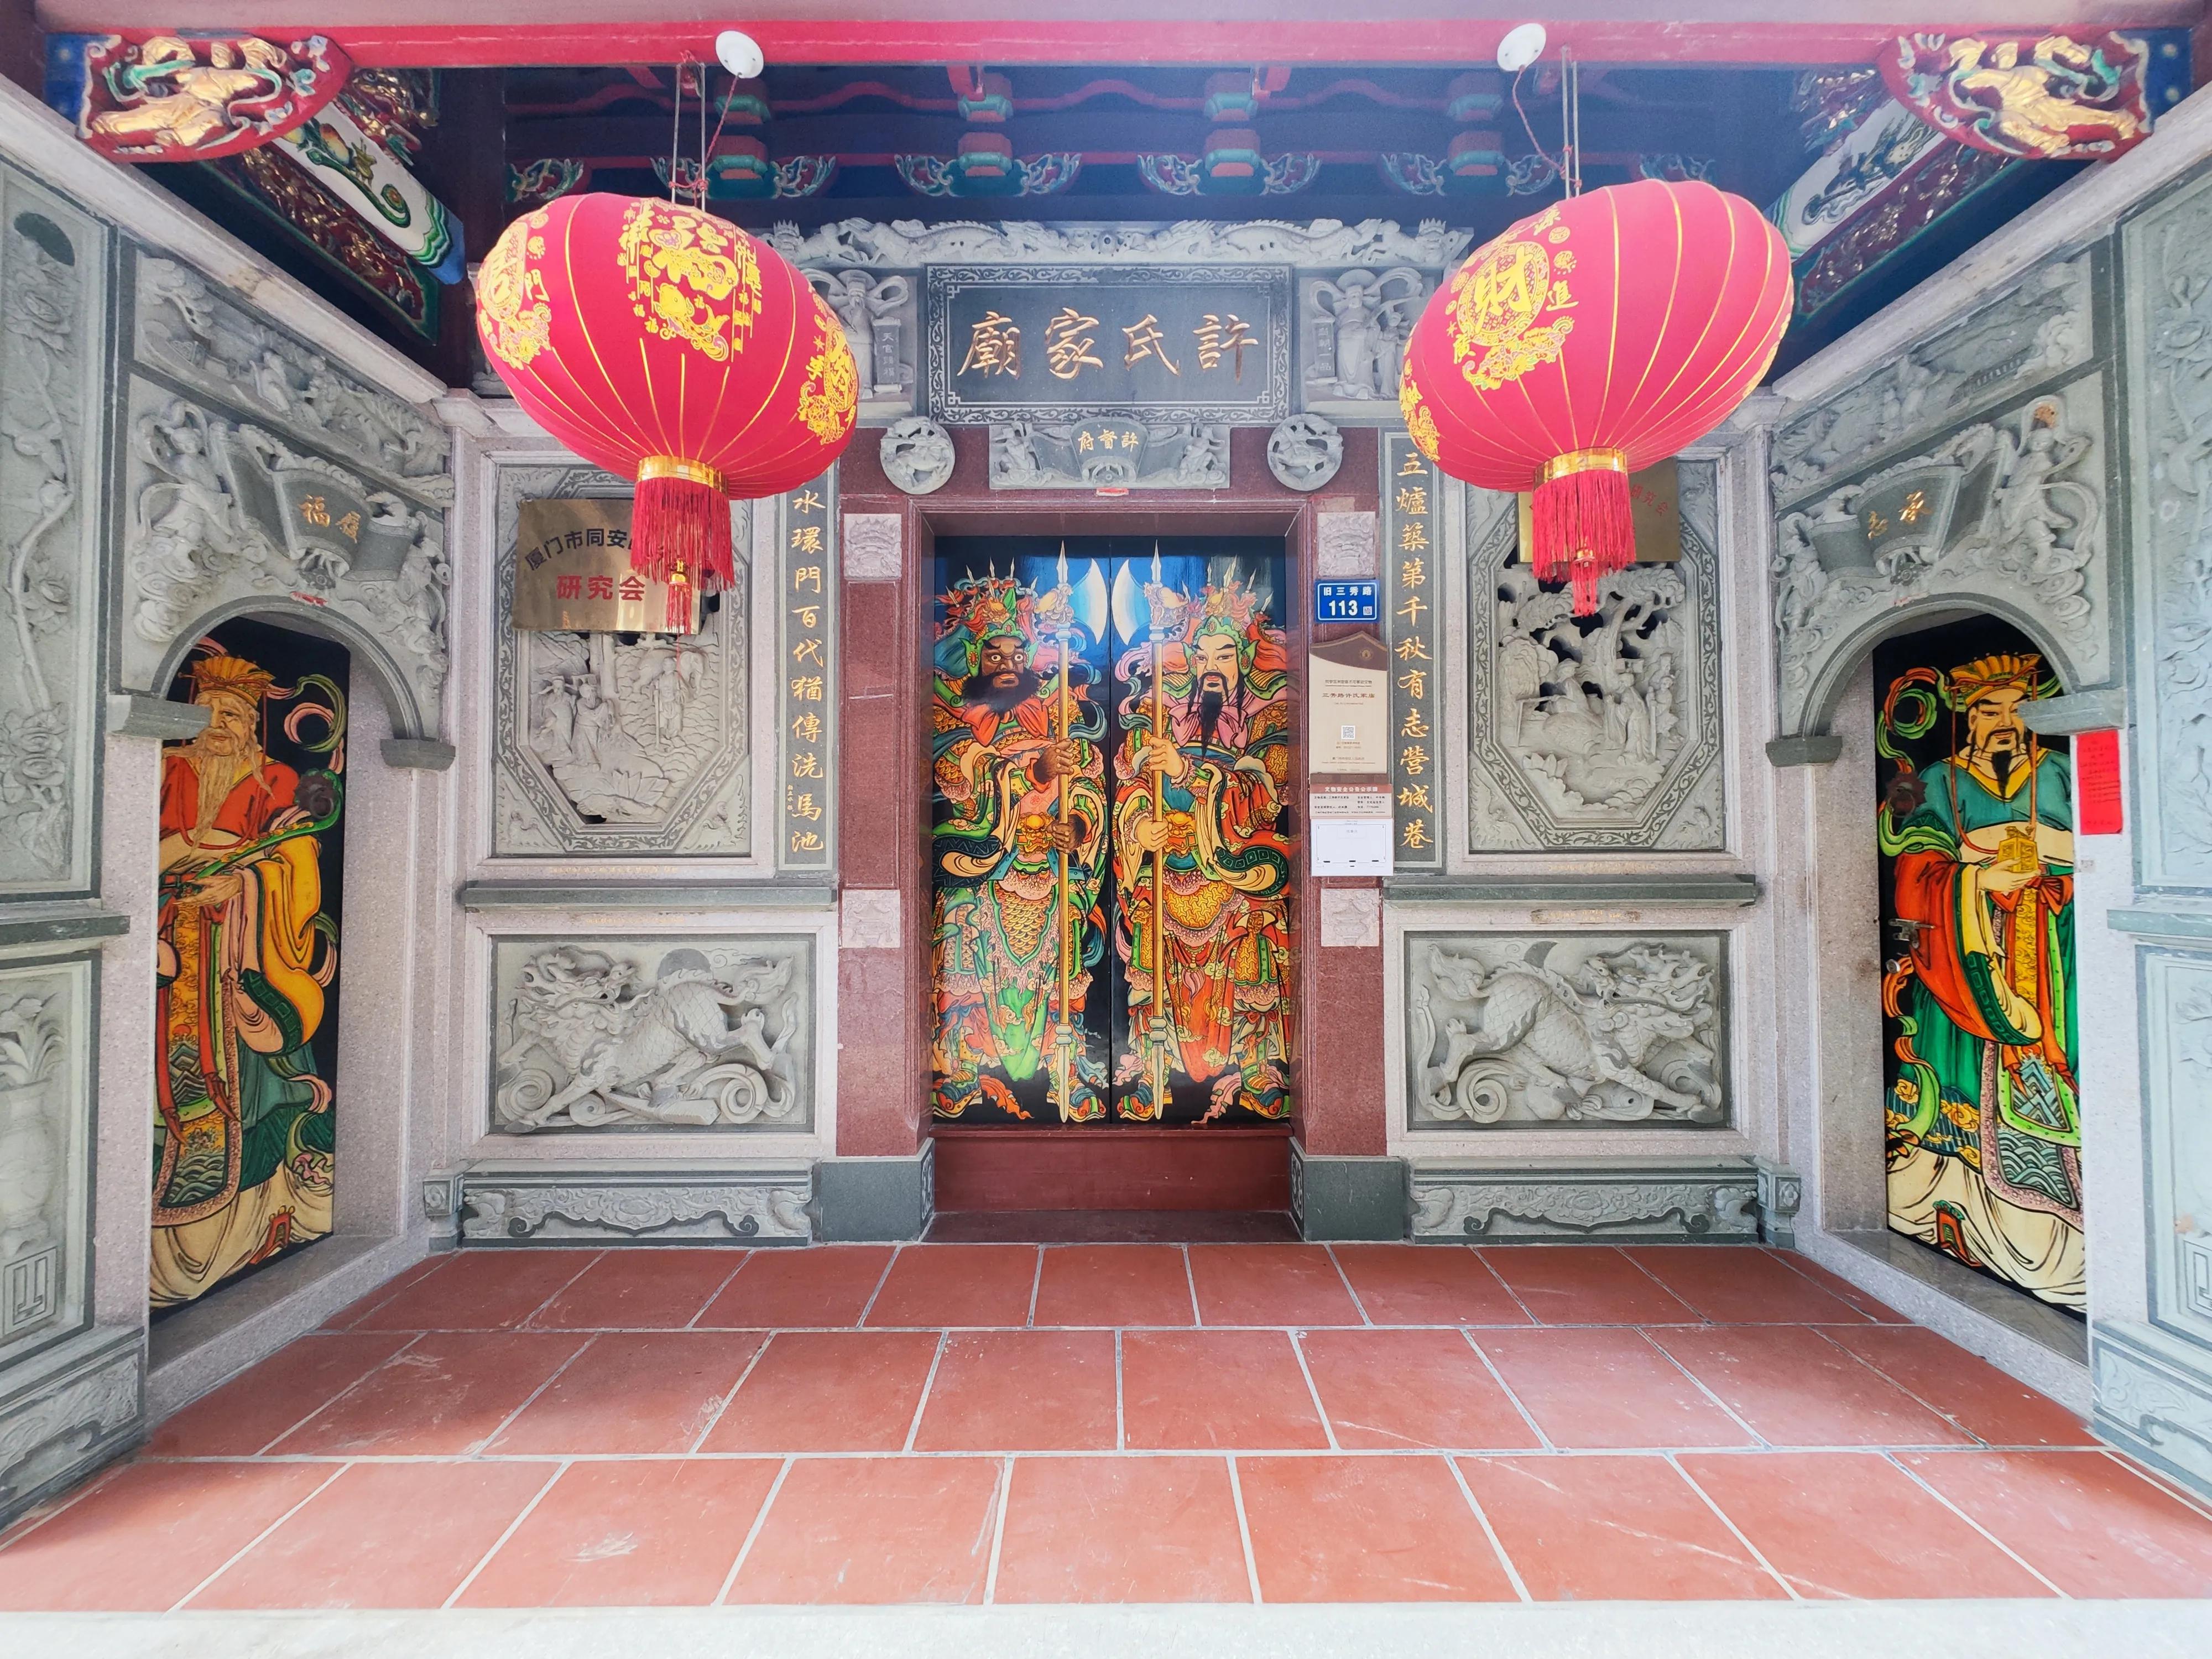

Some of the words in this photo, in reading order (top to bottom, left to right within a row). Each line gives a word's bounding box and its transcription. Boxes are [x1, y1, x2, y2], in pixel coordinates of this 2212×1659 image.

[1473, 246, 1534, 334] 財
[957, 307, 1259, 384] 許氏家廟
[1078, 429, 1139, 455] 許督府
[525, 529, 633, 571] 厦门市同安
[556, 575, 646, 602] 研究会
[1323, 586, 1372, 596] 旧三秀路
[1329, 600, 1358, 616] 113
